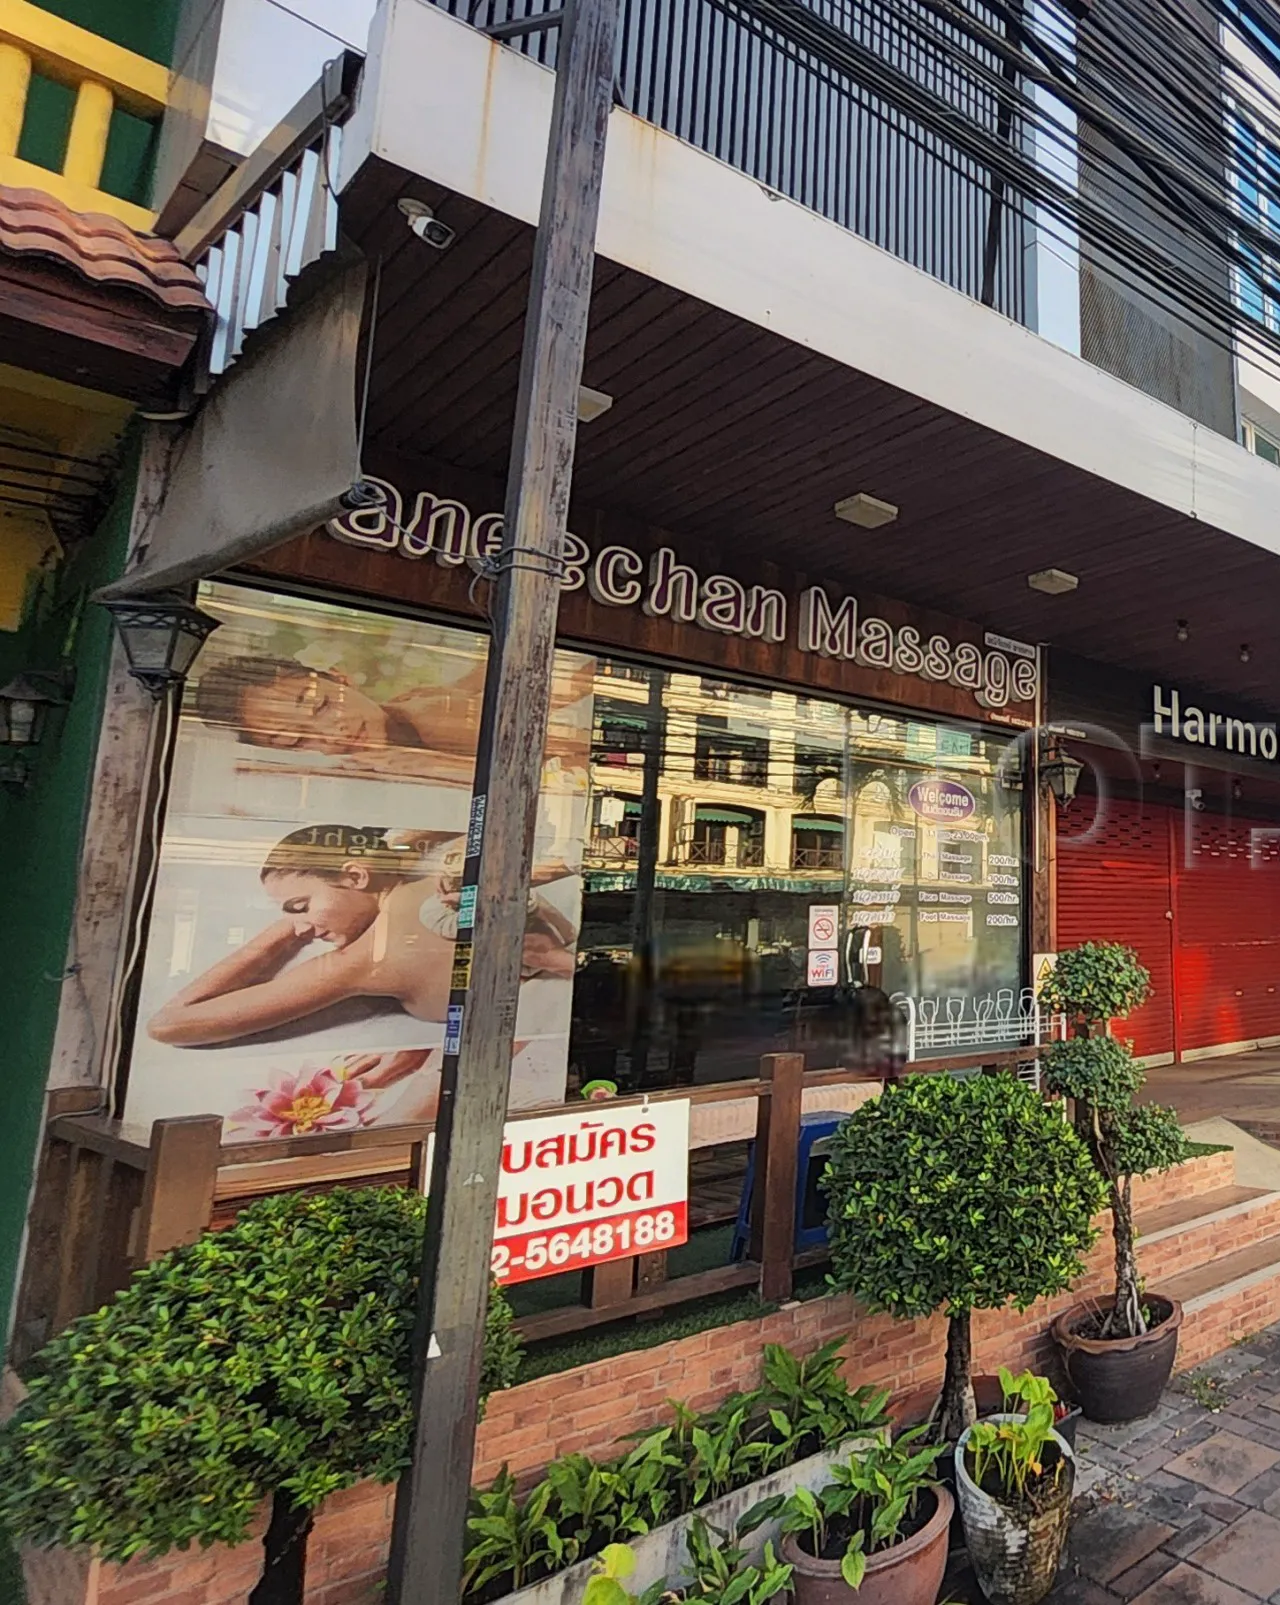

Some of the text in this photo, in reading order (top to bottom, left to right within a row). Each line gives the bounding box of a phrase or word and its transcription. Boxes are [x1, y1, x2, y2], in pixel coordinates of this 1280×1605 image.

[808, 586, 1036, 707] Massage
[917, 786, 969, 807] Welcome
[891, 827, 915, 837] Open
